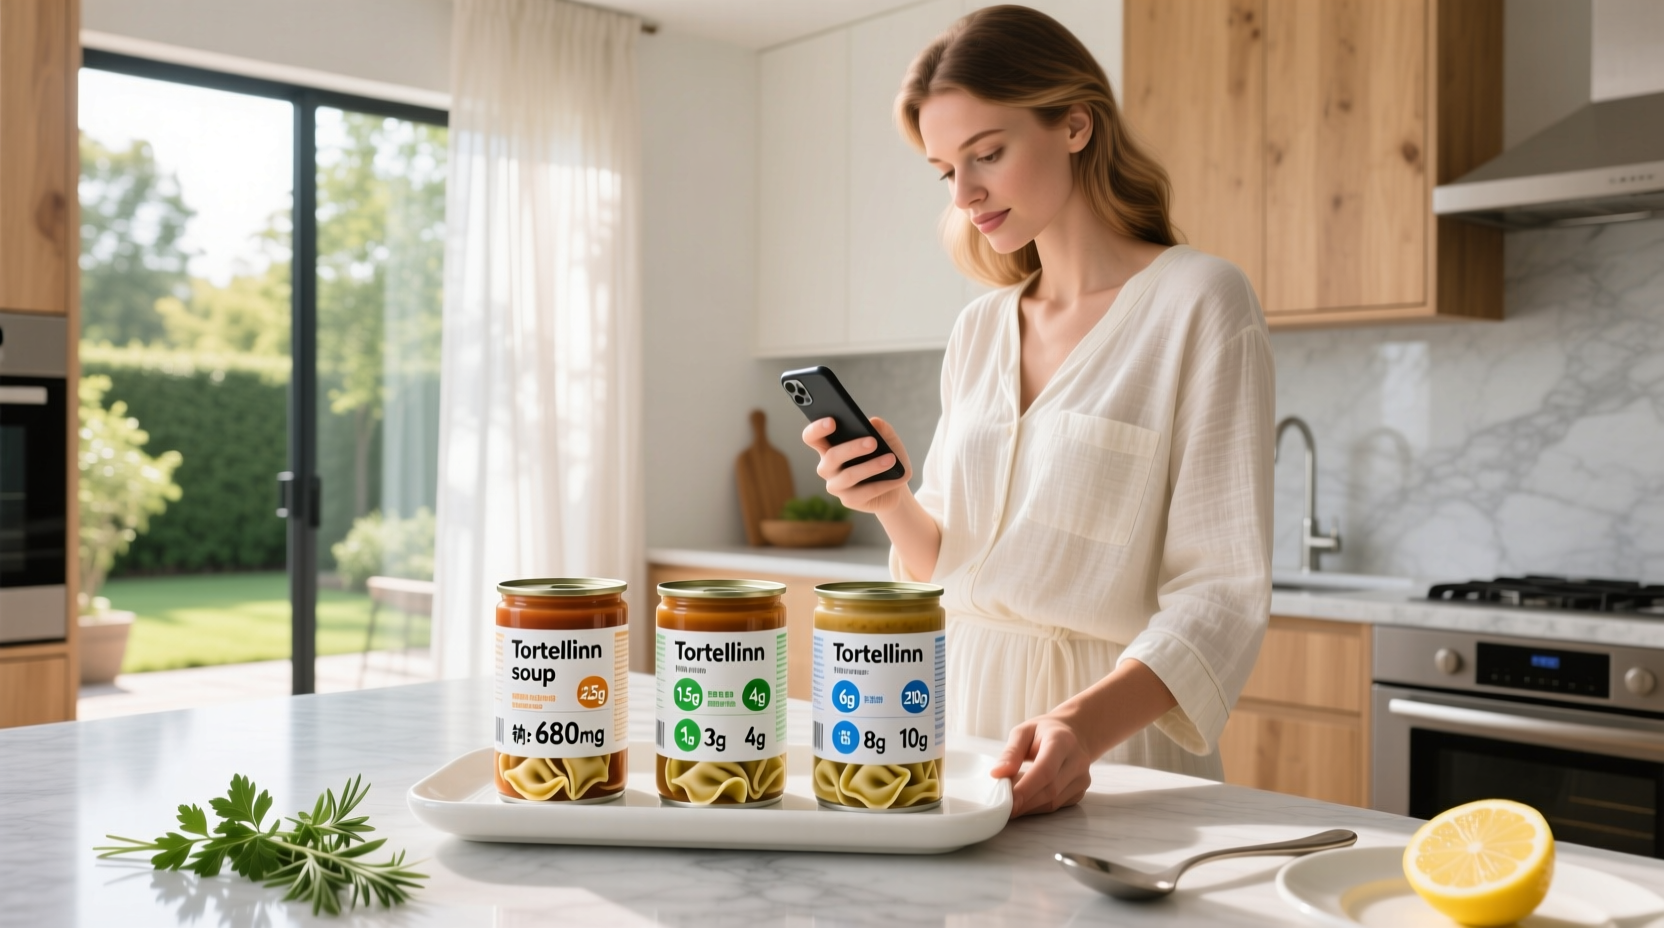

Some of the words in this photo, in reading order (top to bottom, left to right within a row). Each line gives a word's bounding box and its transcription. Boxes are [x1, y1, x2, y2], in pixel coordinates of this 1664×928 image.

[511, 639, 602, 660] Tortellinn
[674, 640, 765, 662] Tortellinn
[833, 642, 923, 663] Tortellinn
[511, 666, 556, 687] soup
[749, 686, 766, 707] 4g
[839, 689, 855, 709] 6g
[535, 721, 605, 748] 680mg
[704, 727, 726, 752] 3g
[744, 726, 766, 750] 4g
[863, 730, 886, 754] 8g
[899, 727, 928, 752] 10g
